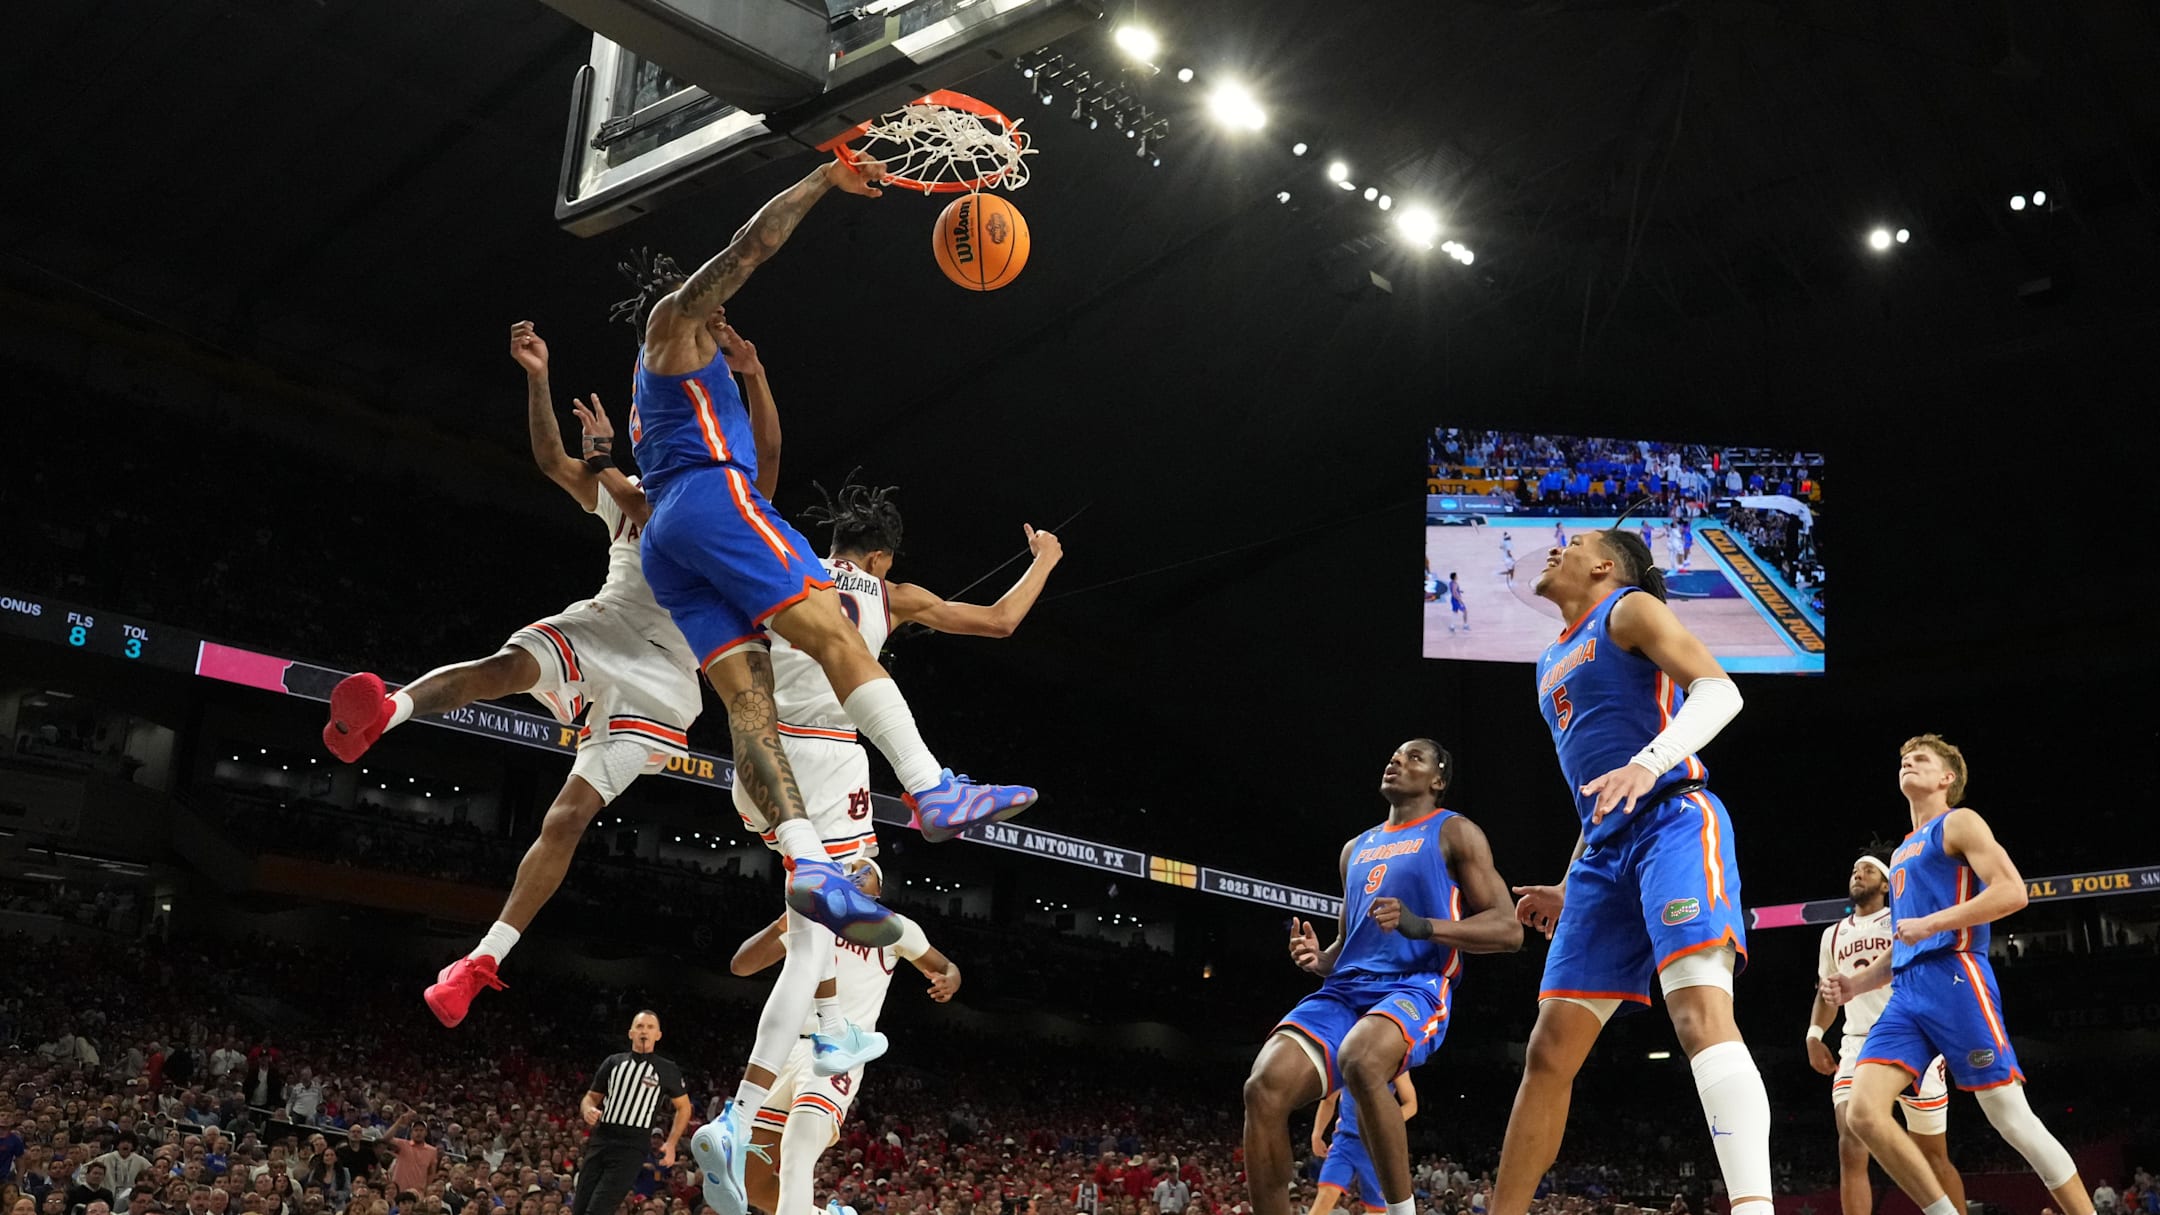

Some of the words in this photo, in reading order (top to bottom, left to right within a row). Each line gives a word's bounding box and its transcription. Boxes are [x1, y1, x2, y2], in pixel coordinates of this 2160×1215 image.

[953, 200, 974, 264] Wilson
[0, 597, 42, 616] ONUS
[67, 612, 94, 628] FLS
[123, 624, 149, 641] TOL
[69, 626, 87, 647] 8
[124, 638, 142, 659] 3
[1551, 683, 1573, 732] 5
[478, 711, 509, 733] NCAA
[513, 719, 550, 741] MEN'S
[666, 756, 715, 779] OUR
[984, 824, 1019, 845] SAN
[1024, 833, 1099, 865] ANTONIO,
[1103, 850, 1124, 868] TX
[1352, 838, 1424, 866] FLORIDA
[1364, 863, 1388, 895] 9
[2071, 873, 2132, 893] FOUR
[1219, 878, 1249, 896] 2025
[1252, 884, 1287, 904] NCAA
[1290, 892, 1329, 912] MEN'S
